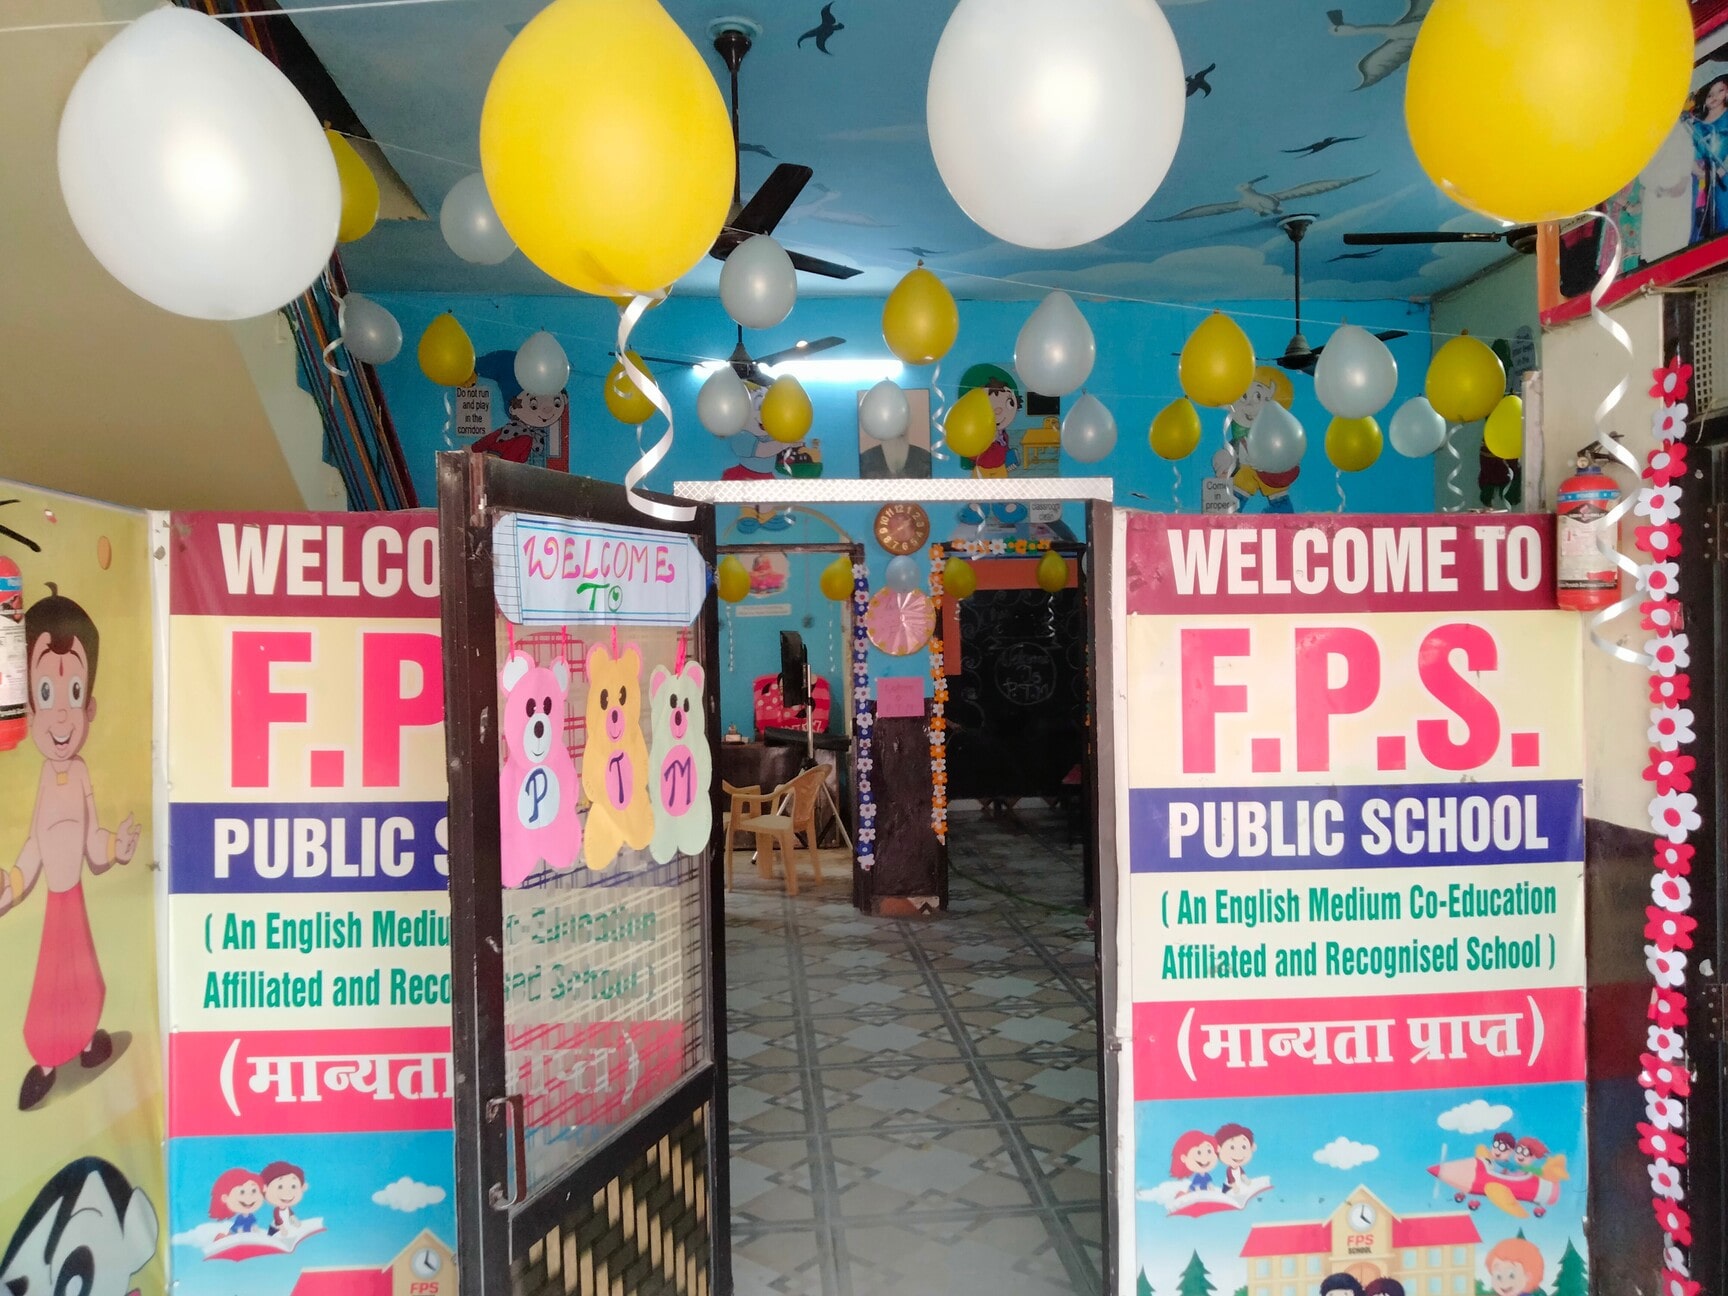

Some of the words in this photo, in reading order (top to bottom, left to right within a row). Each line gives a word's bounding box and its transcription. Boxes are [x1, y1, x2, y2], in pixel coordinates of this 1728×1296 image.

[457, 388, 466, 397] Do
[463, 400, 474, 409] and
[476, 400, 489, 412] play
[457, 425, 486, 434] corridors
[472, 413, 483, 423] the
[894, 504, 904, 514] 12
[1206, 499, 1230, 511] proper
[1214, 490, 1221, 500] in
[523, 535, 675, 583] WELCOME
[1167, 526, 1459, 595] WELCOME
[1475, 525, 1542, 592] TO
[576, 583, 623, 613] TO
[1181, 623, 1540, 773] F.P.S.
[525, 767, 548, 823] P
[608, 752, 625, 804] T
[664, 756, 692, 808] M
[1168, 799, 1344, 858] PUBLIC
[1361, 794, 1548, 856] SCHOOL
[214, 817, 415, 878] PUBLIC
[1177, 891, 1206, 925] An
[1215, 889, 1300, 928] English
[1309, 886, 1401, 922] Medium
[1409, 881, 1556, 919] Co-Education
[223, 913, 256, 950] An
[266, 910, 362, 953] English
[1162, 943, 1266, 980] Affiliated
[1275, 941, 1317, 977] and
[1325, 937, 1458, 978] Recognised
[1466, 934, 1541, 970] School
[203, 970, 323, 1009] Affiliated
[333, 969, 380, 1006] and
[1177, 1007, 1395, 1082] (मान्यता
[1407, 995, 1545, 1067] प्राप्त)
[1347, 1234, 1374, 1247] FPS
[410, 1282, 439, 1295] FPS
